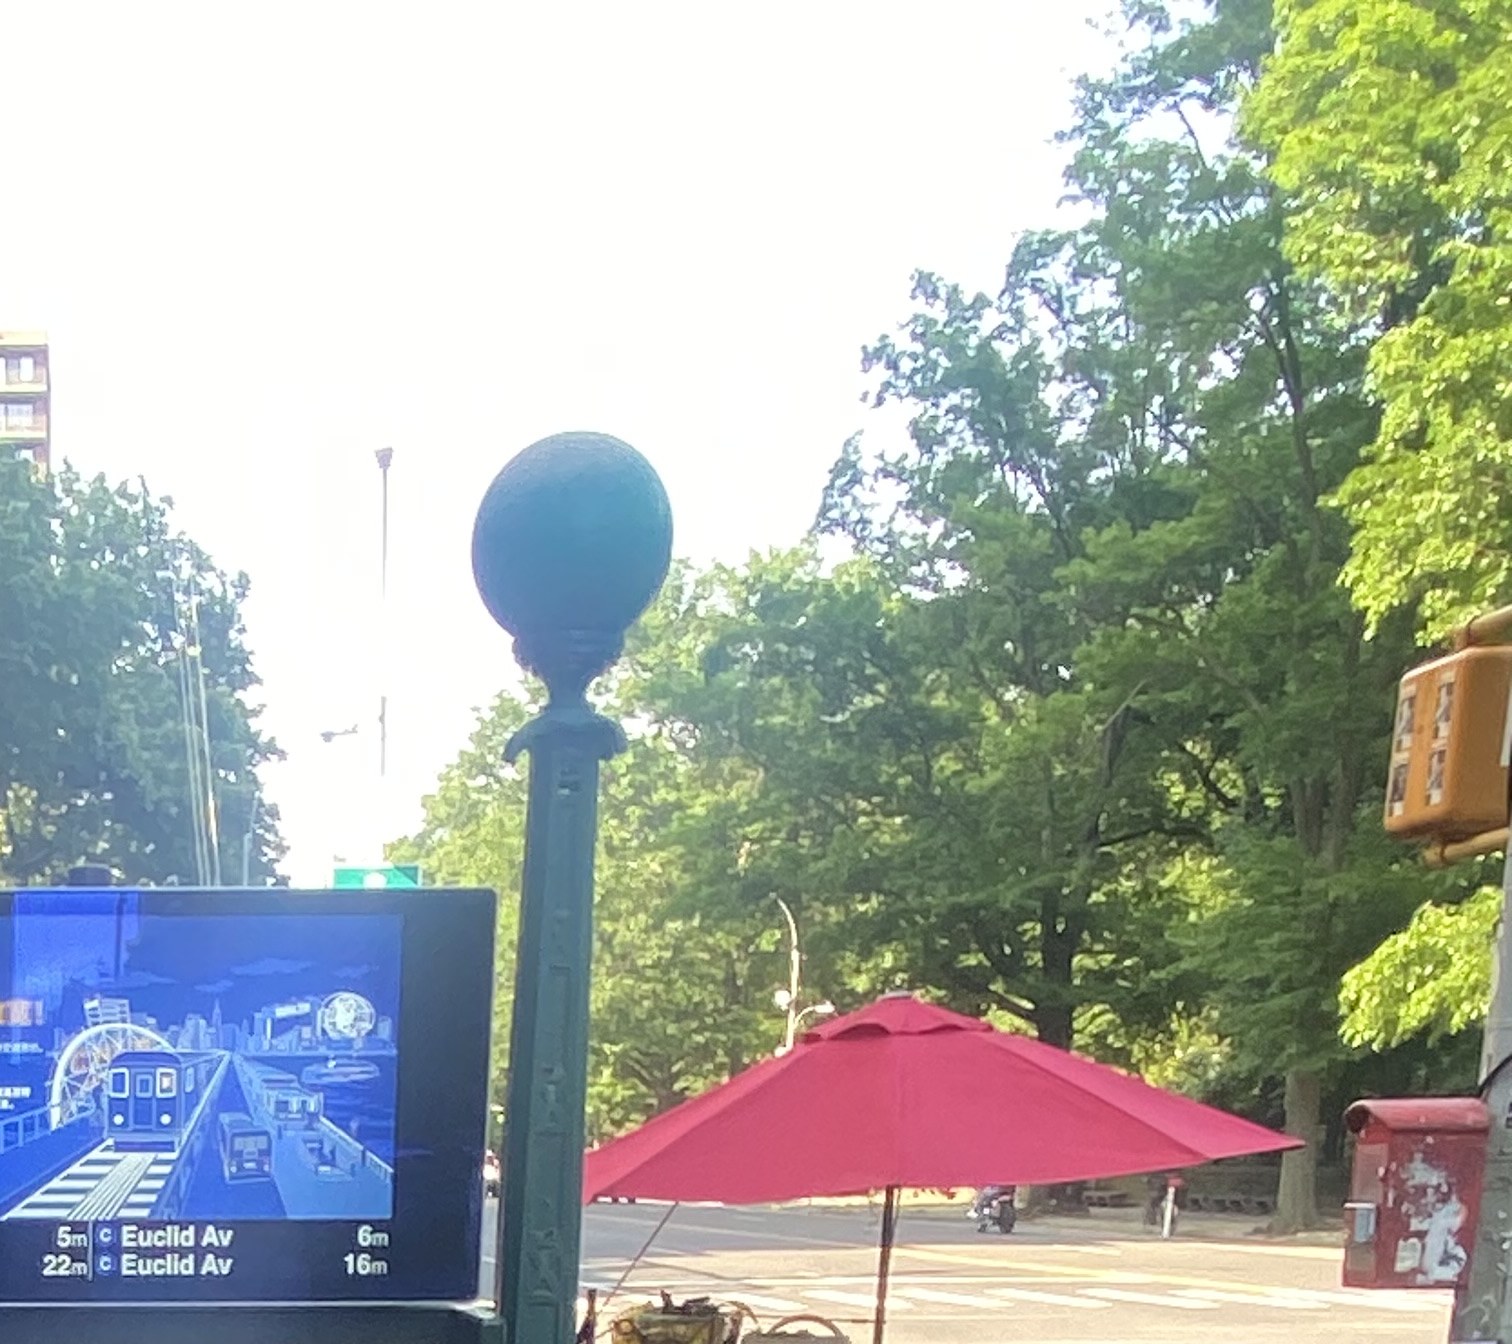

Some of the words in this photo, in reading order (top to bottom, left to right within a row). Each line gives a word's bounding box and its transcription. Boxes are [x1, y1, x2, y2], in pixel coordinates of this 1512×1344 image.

[57, 1226, 88, 1248] 5m
[121, 1225, 195, 1247] Euclid
[201, 1226, 234, 1247] Av
[357, 1225, 389, 1247] 6m
[42, 1255, 88, 1276] 22m
[121, 1253, 195, 1275] Euclid
[201, 1254, 234, 1275] Av
[344, 1253, 389, 1275] 16m
